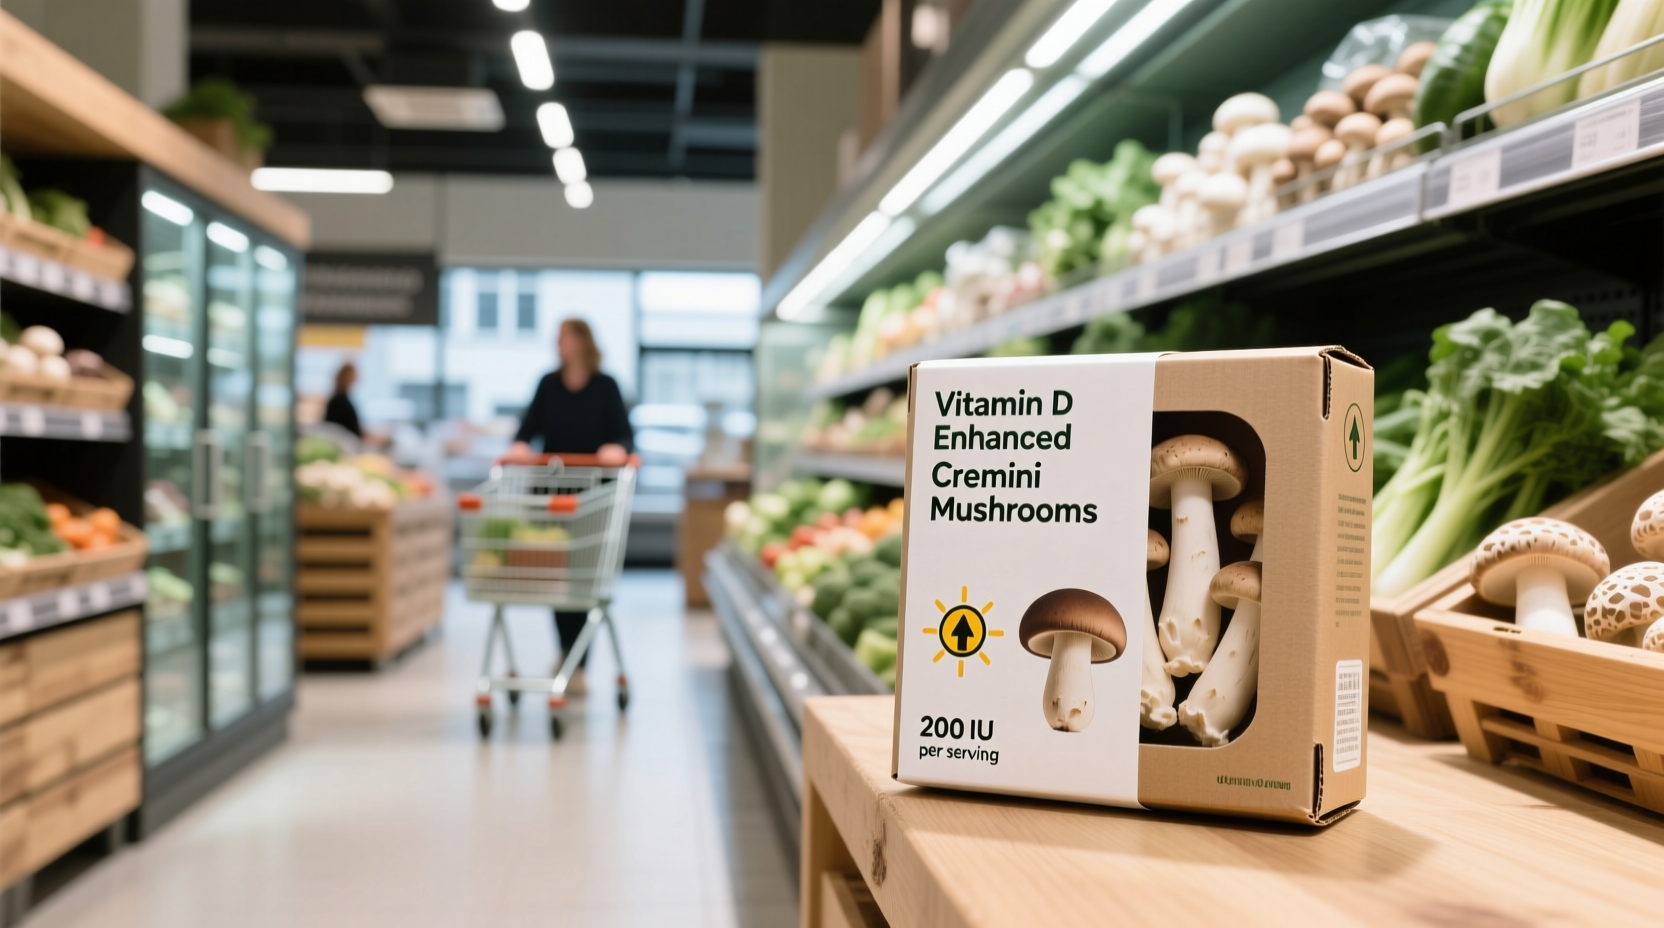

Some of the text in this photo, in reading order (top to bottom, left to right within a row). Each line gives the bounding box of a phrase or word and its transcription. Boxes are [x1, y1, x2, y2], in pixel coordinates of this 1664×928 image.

[934, 389, 1074, 417] Vitamin D
[933, 423, 1072, 451] Enhanced
[931, 460, 1042, 489] Cremini
[930, 494, 1098, 523] Mushrooms
[919, 715, 994, 741] 200 IU
[919, 745, 999, 765] per serving
